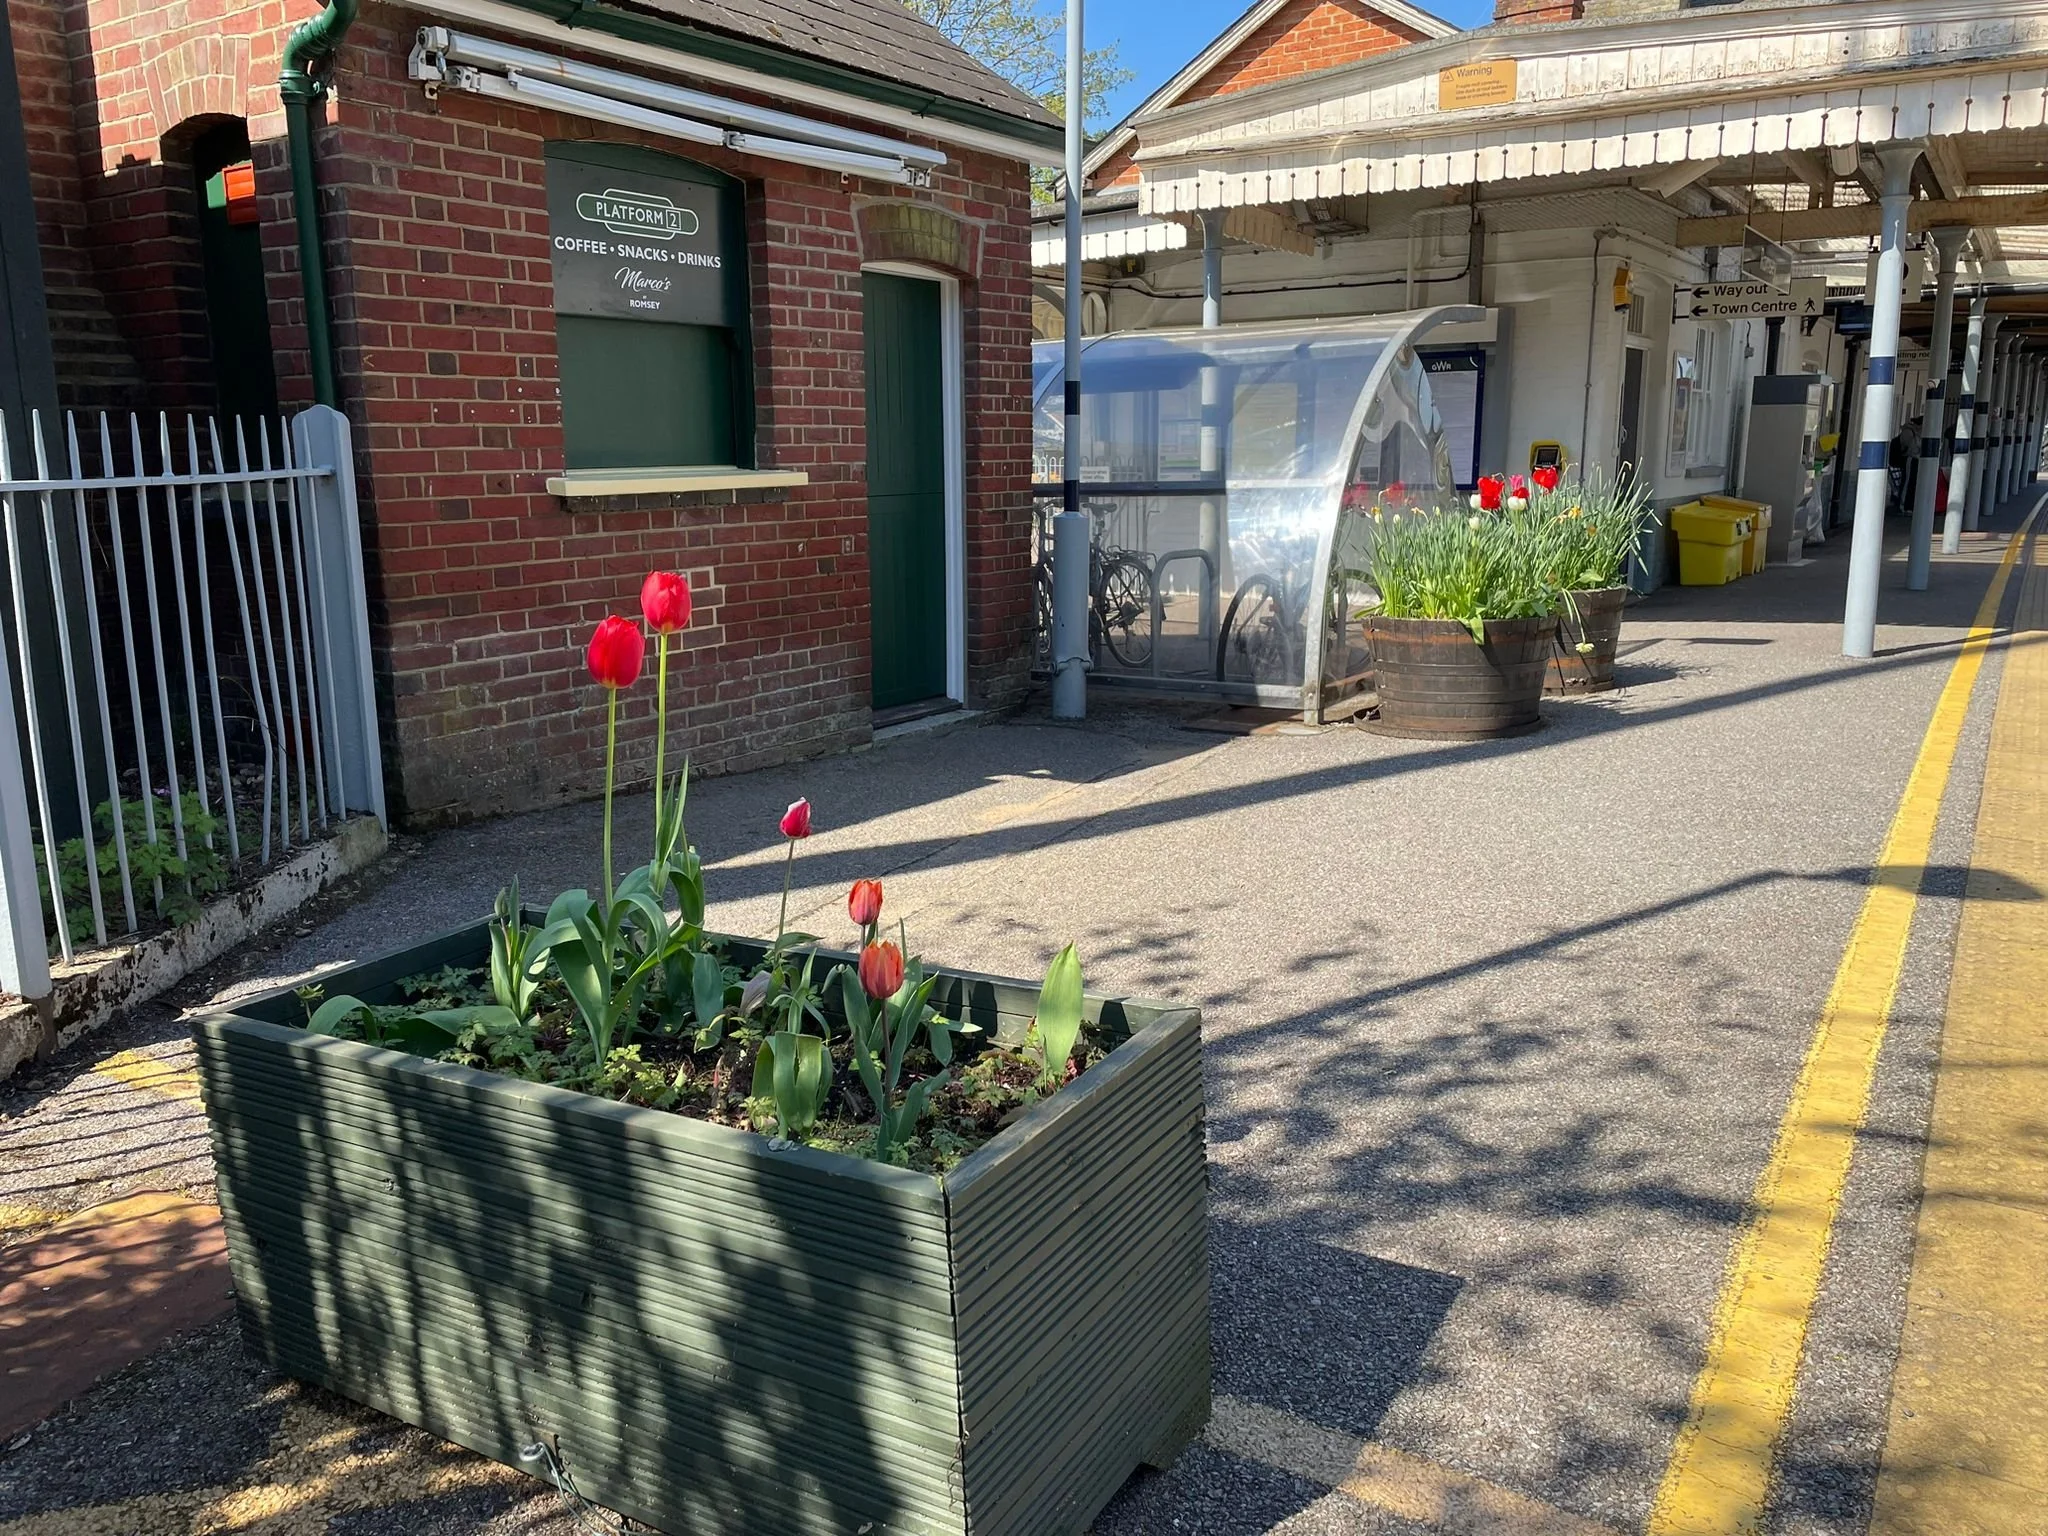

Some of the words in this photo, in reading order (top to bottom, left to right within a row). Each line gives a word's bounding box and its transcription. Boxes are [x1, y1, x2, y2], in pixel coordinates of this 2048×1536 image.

[1456, 66, 1493, 77] Warning
[595, 201, 664, 225] PLATFORM
[669, 212, 678, 228] 2
[554, 236, 607, 255] COFFEE
[617, 244, 668, 262] SNACKS
[678, 252, 722, 269] DRINKS
[614, 266, 672, 293] Marco's
[1713, 284, 1743, 297] Way
[1746, 283, 1769, 295] out
[629, 299, 661, 310] ROMSEY
[1712, 303, 1748, 315] Town
[1751, 301, 1798, 313] Centre
